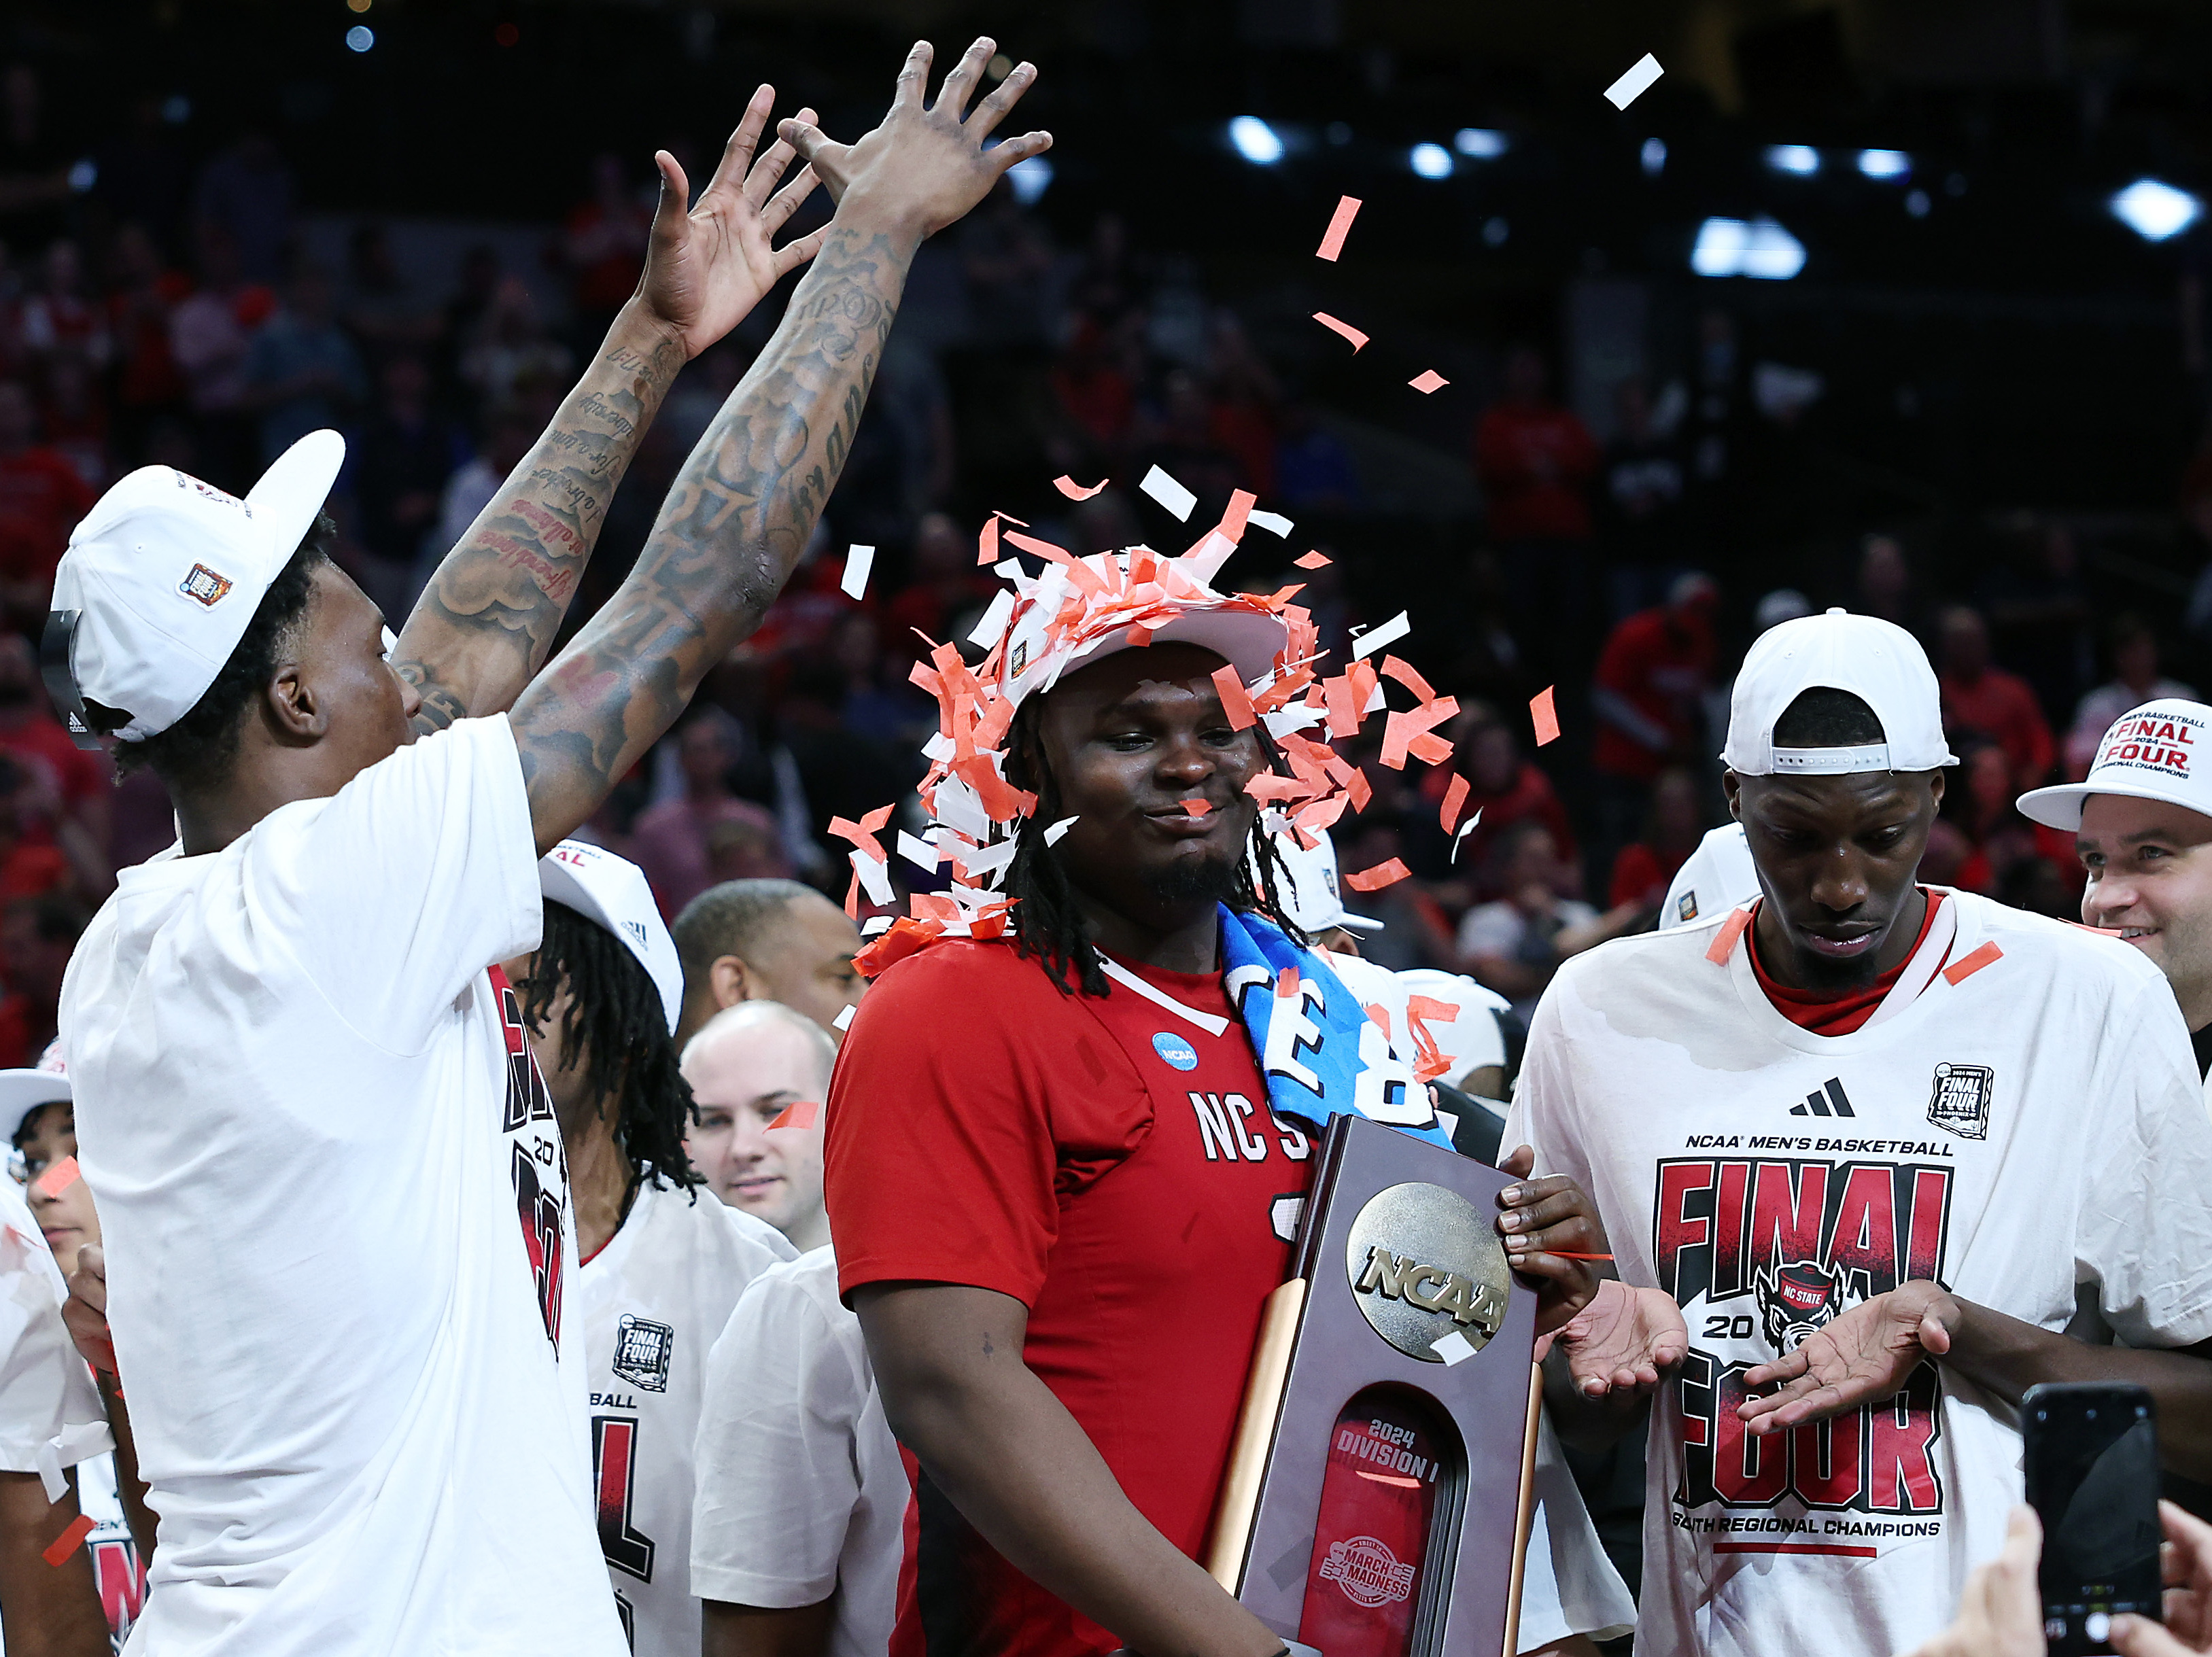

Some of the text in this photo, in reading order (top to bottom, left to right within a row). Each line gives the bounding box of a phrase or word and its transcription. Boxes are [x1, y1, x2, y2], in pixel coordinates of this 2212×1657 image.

[2144, 712, 2205, 729] BASKETBALL
[2115, 720, 2194, 745] FINAL
[2133, 737, 2159, 746] 2024
[2105, 744, 2188, 771] FOUR
[2135, 763, 2190, 780] CHAMPIONS
[621, 922, 649, 952] adidas
[1162, 1049, 1195, 1060] NCAA
[1939, 1077, 1981, 1094] FINAL
[1937, 1092, 1979, 1110] FOUR
[1188, 1090, 1268, 1163] NC
[1749, 1136, 1813, 1151] MEN'S
[1815, 1137, 1954, 1157] BASKETBALL
[1653, 1157, 1955, 1304] FINAL
[1355, 1245, 1504, 1340] NCAA
[1783, 1285, 1823, 1306] NC STATE
[1702, 1315, 1753, 1339] 20
[624, 1329, 662, 1348] FINAL
[622, 1342, 660, 1362] FOUR
[1368, 1418, 1417, 1450] 2024
[1336, 1429, 1440, 1483] DIVISION I
[1718, 1518, 1819, 1533] REGIONAL
[1824, 1519, 1941, 1536] CHAMPIONS
[1344, 1549, 1391, 1575] MARCH
[1347, 1565, 1409, 1597] MADNESS
